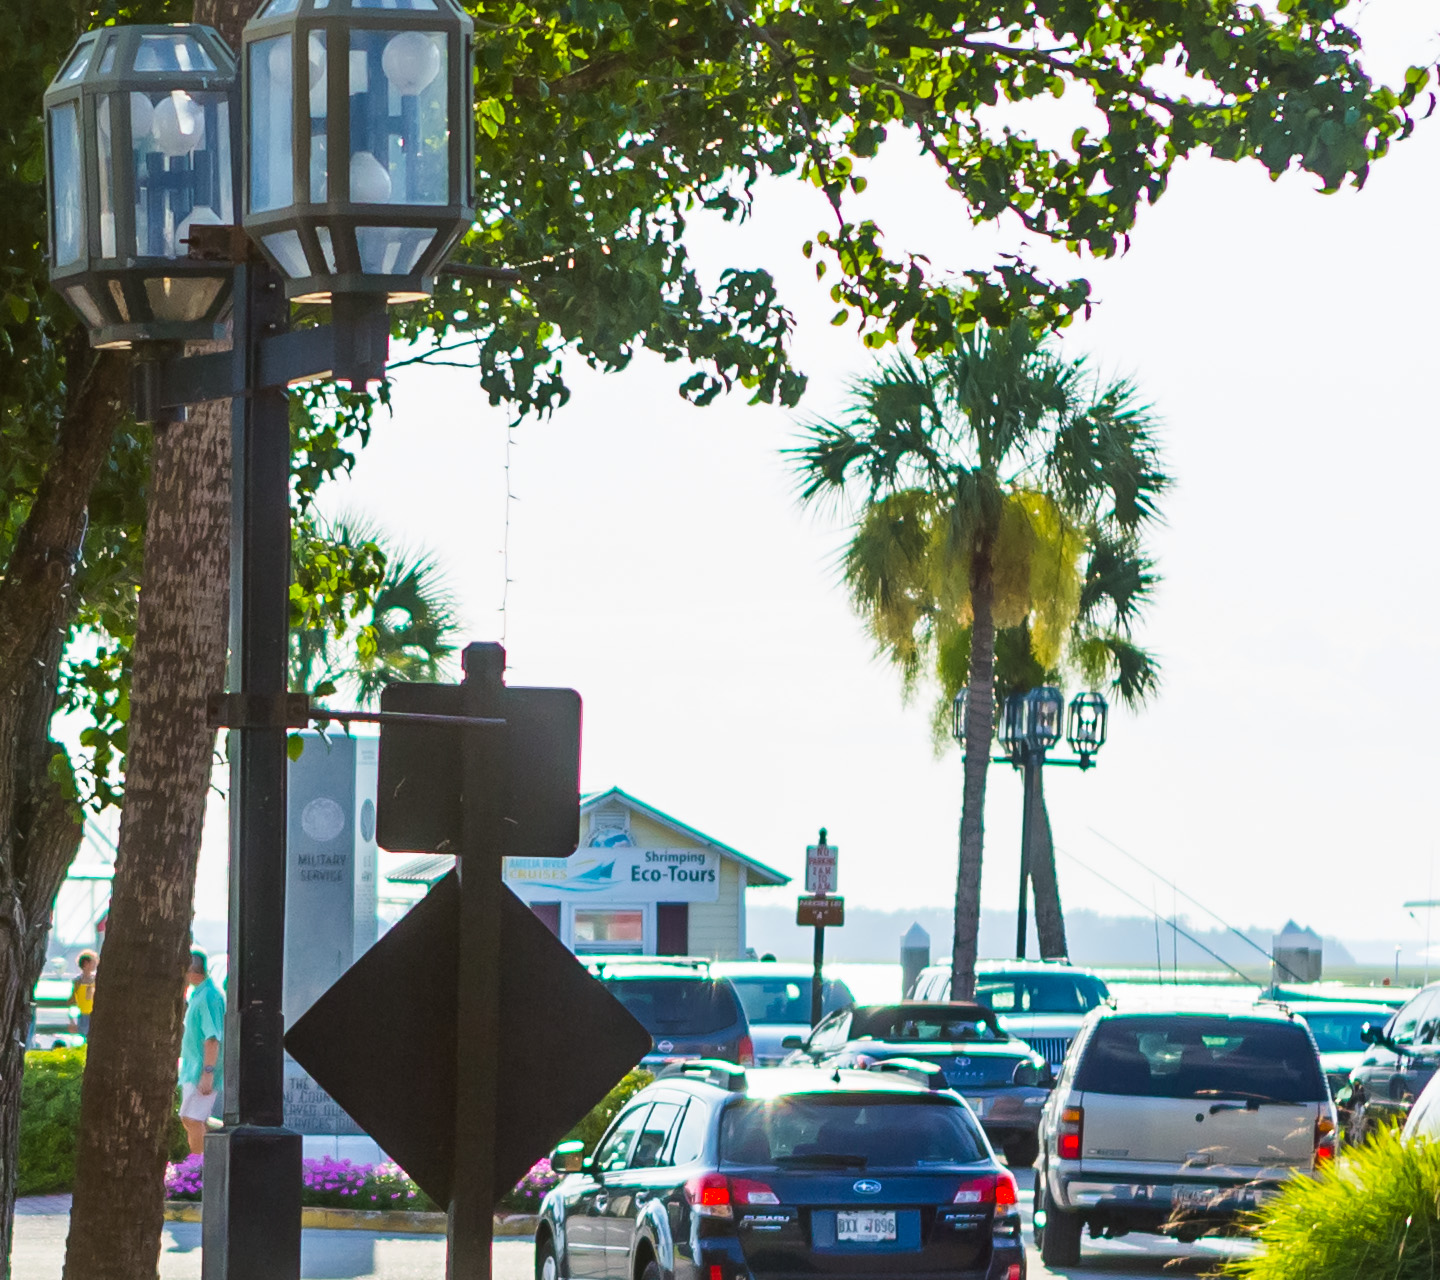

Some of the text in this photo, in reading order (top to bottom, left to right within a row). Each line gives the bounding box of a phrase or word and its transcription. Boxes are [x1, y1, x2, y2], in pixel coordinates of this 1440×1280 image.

[297, 853, 347, 866] MILITARY
[644, 850, 706, 866] Shrimping
[630, 865, 716, 883] Eco-Tours
